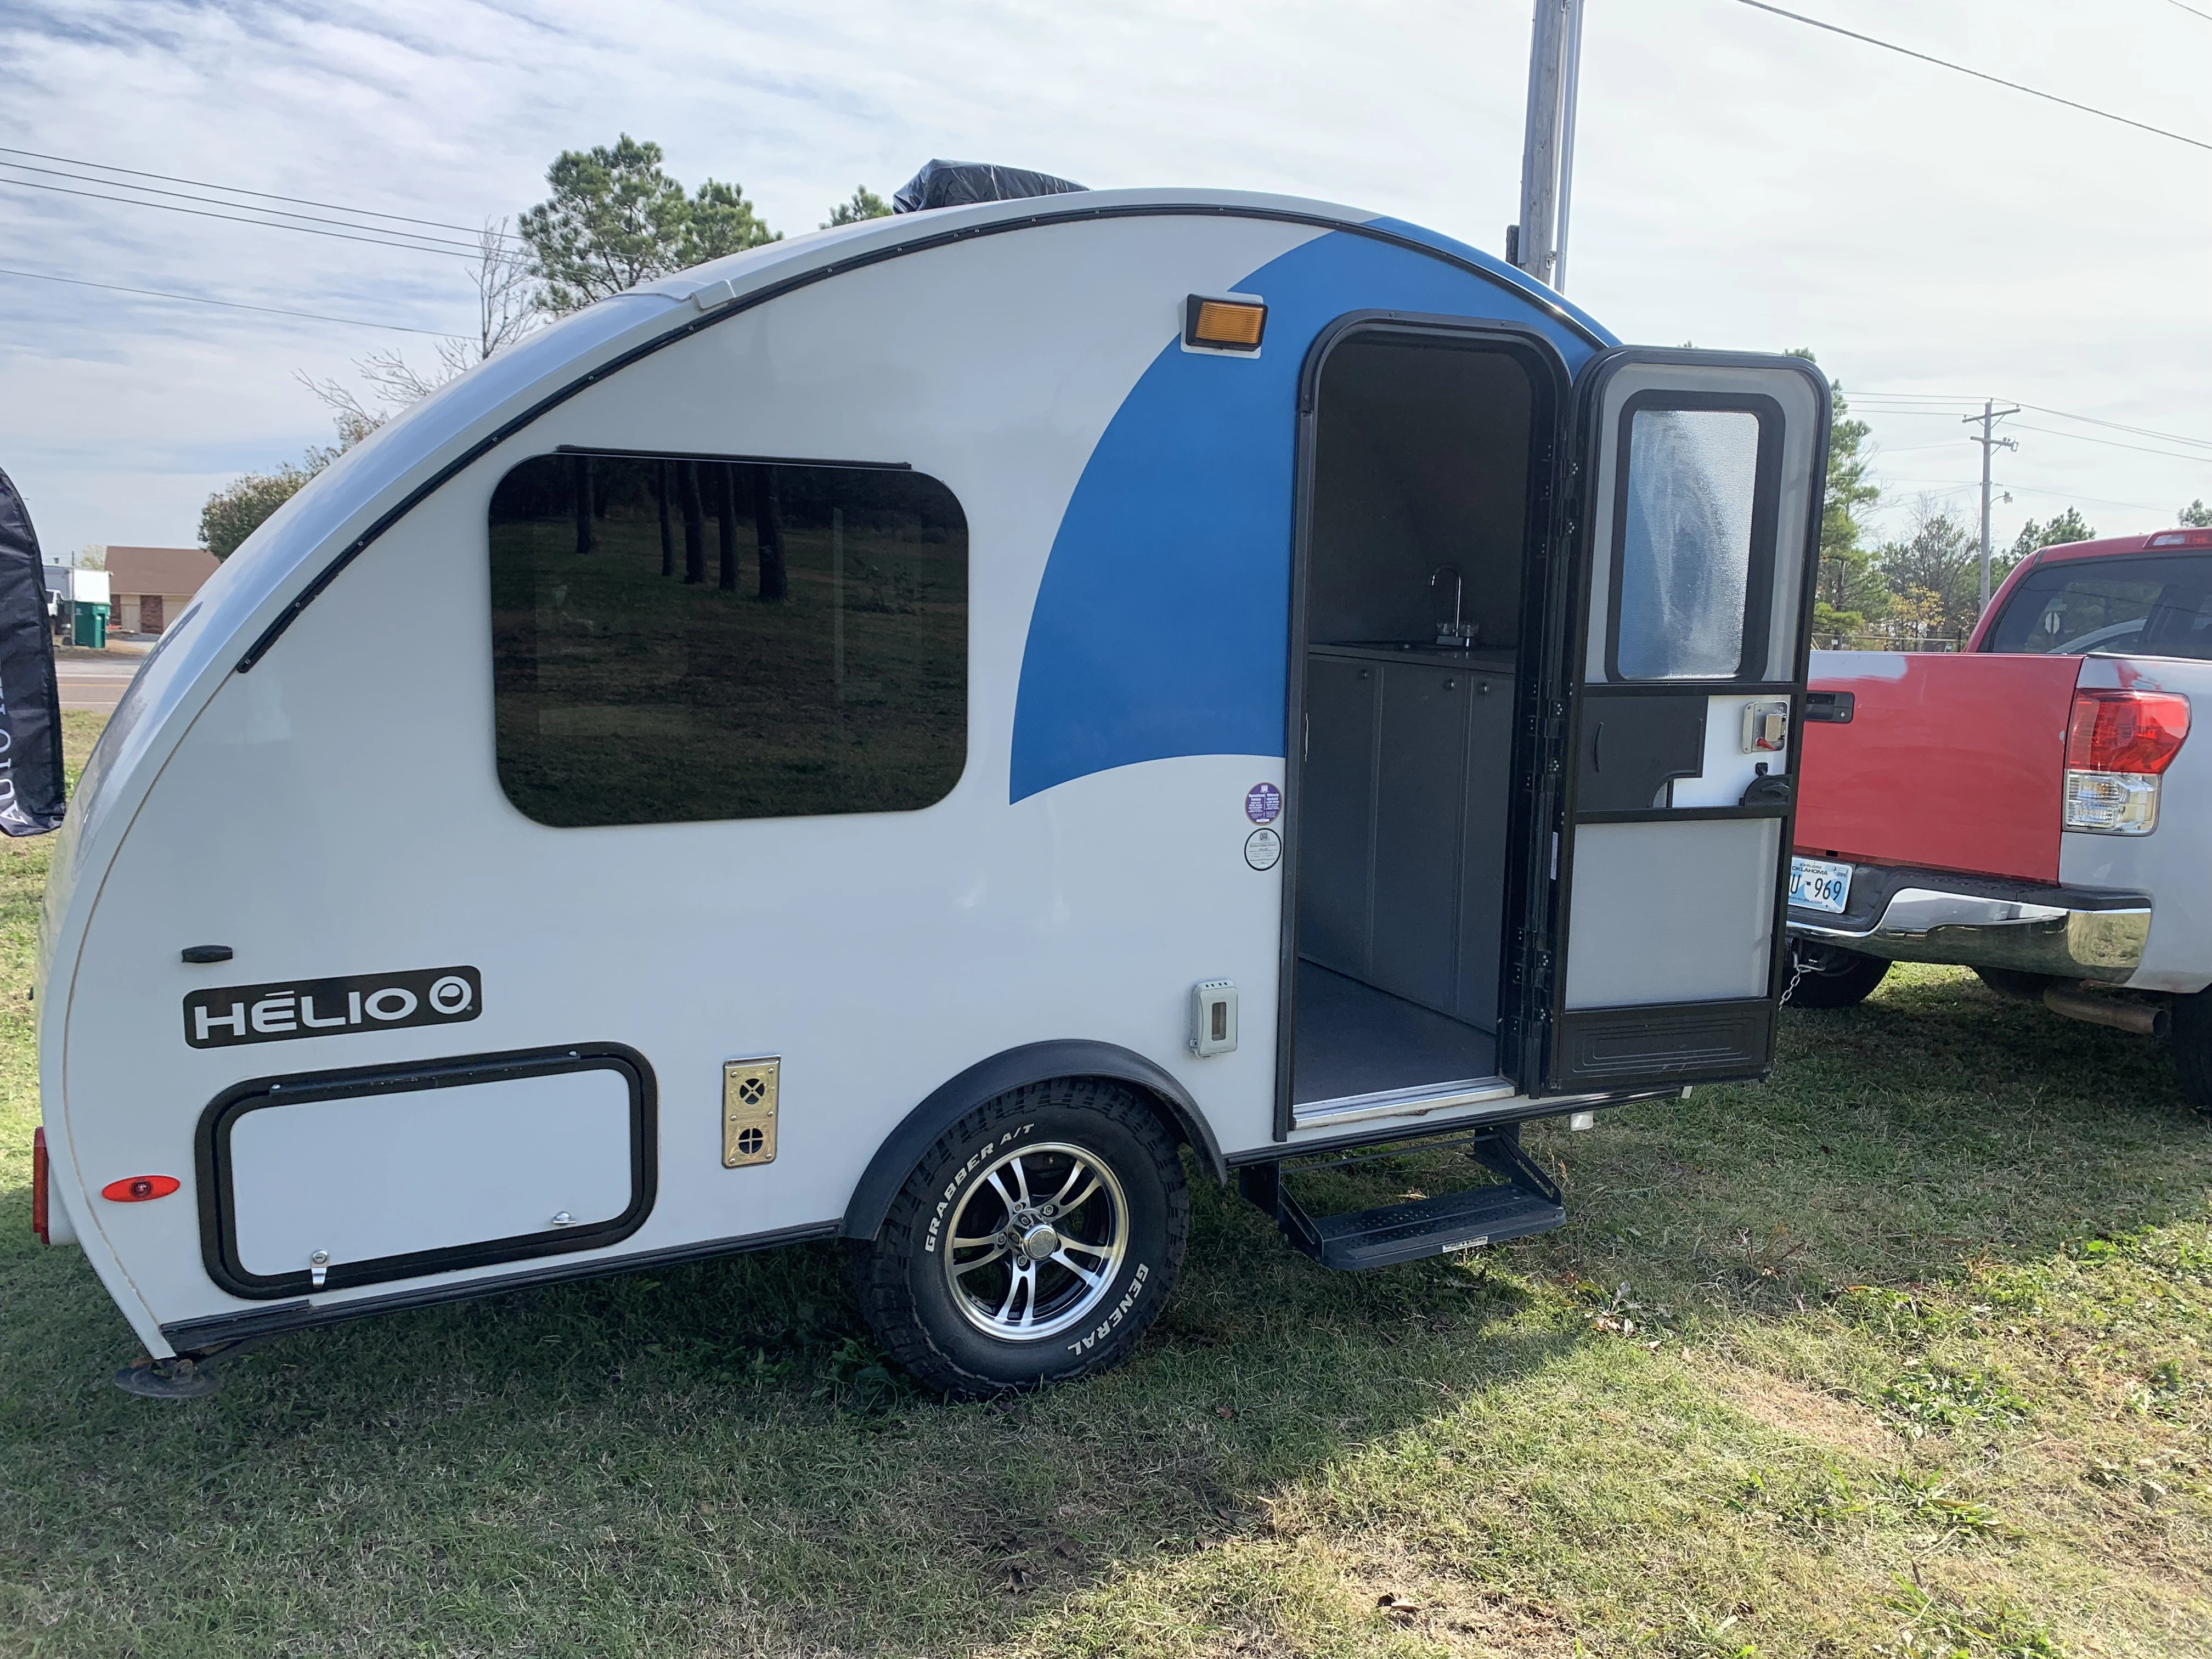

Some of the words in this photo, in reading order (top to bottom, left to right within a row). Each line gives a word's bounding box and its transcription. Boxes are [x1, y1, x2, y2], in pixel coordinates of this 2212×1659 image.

[1792, 866, 1828, 876] OKLAHOMA
[1788, 895, 1823, 905] RAVELOK.COM
[924, 1142, 995, 1252] GRABBER
[1000, 1123, 1035, 1146] A/T
[1066, 1263, 1149, 1356] GENERAL
